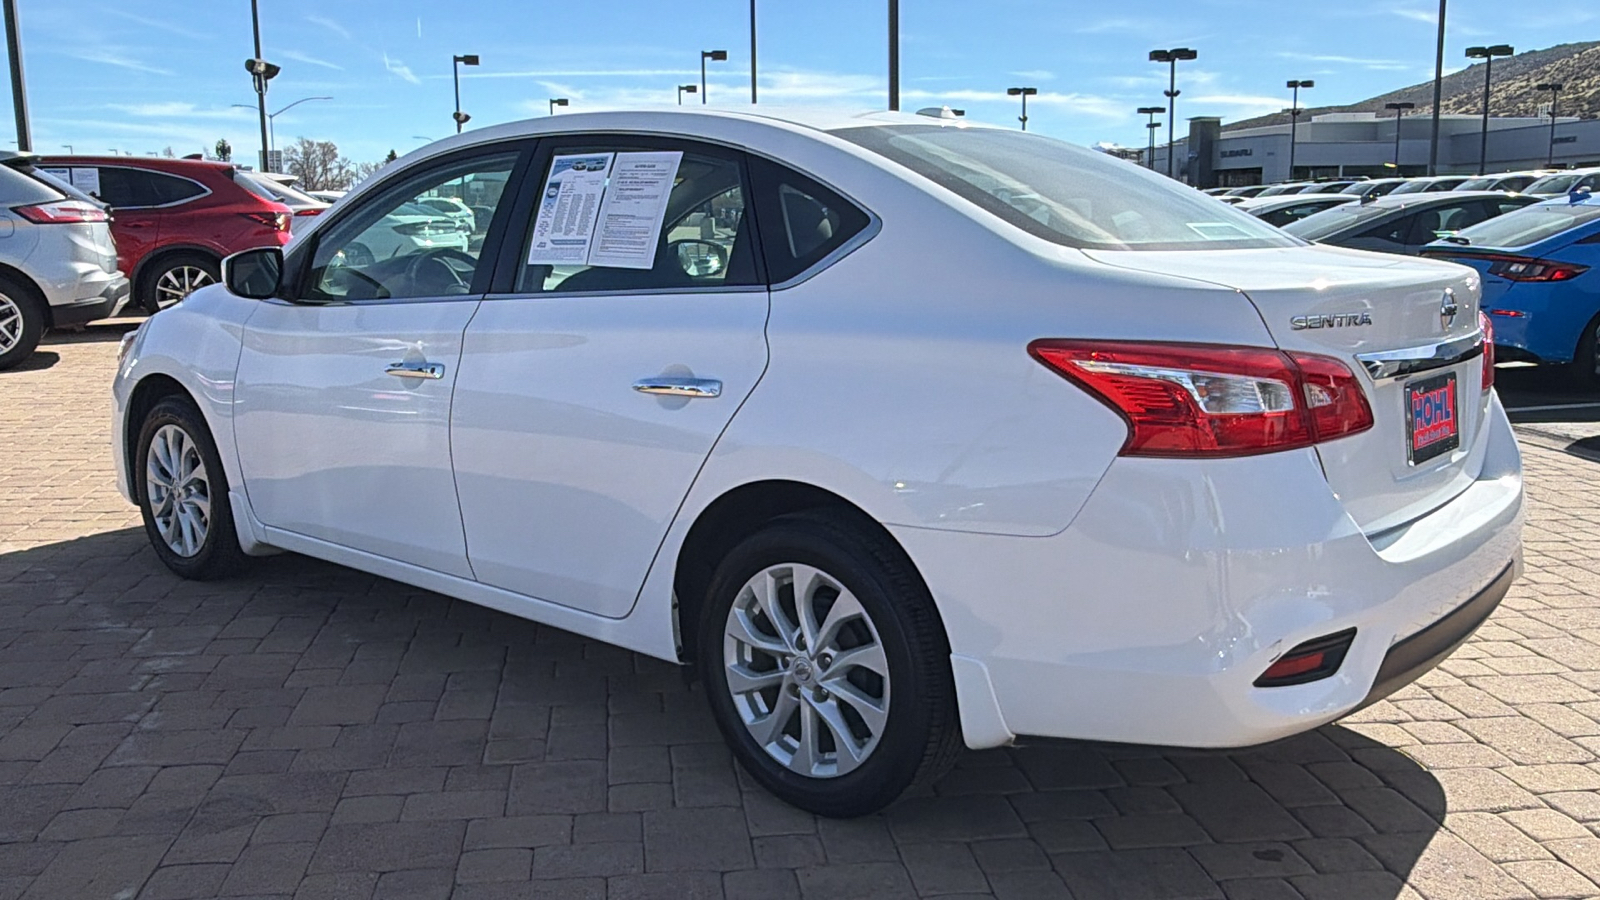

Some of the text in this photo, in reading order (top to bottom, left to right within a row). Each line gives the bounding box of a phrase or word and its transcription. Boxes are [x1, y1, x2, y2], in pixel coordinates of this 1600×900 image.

[1220, 149, 1252, 158] SUBARU
[1290, 312, 1372, 331] SENTRA
[1413, 389, 1451, 431] HOHL
